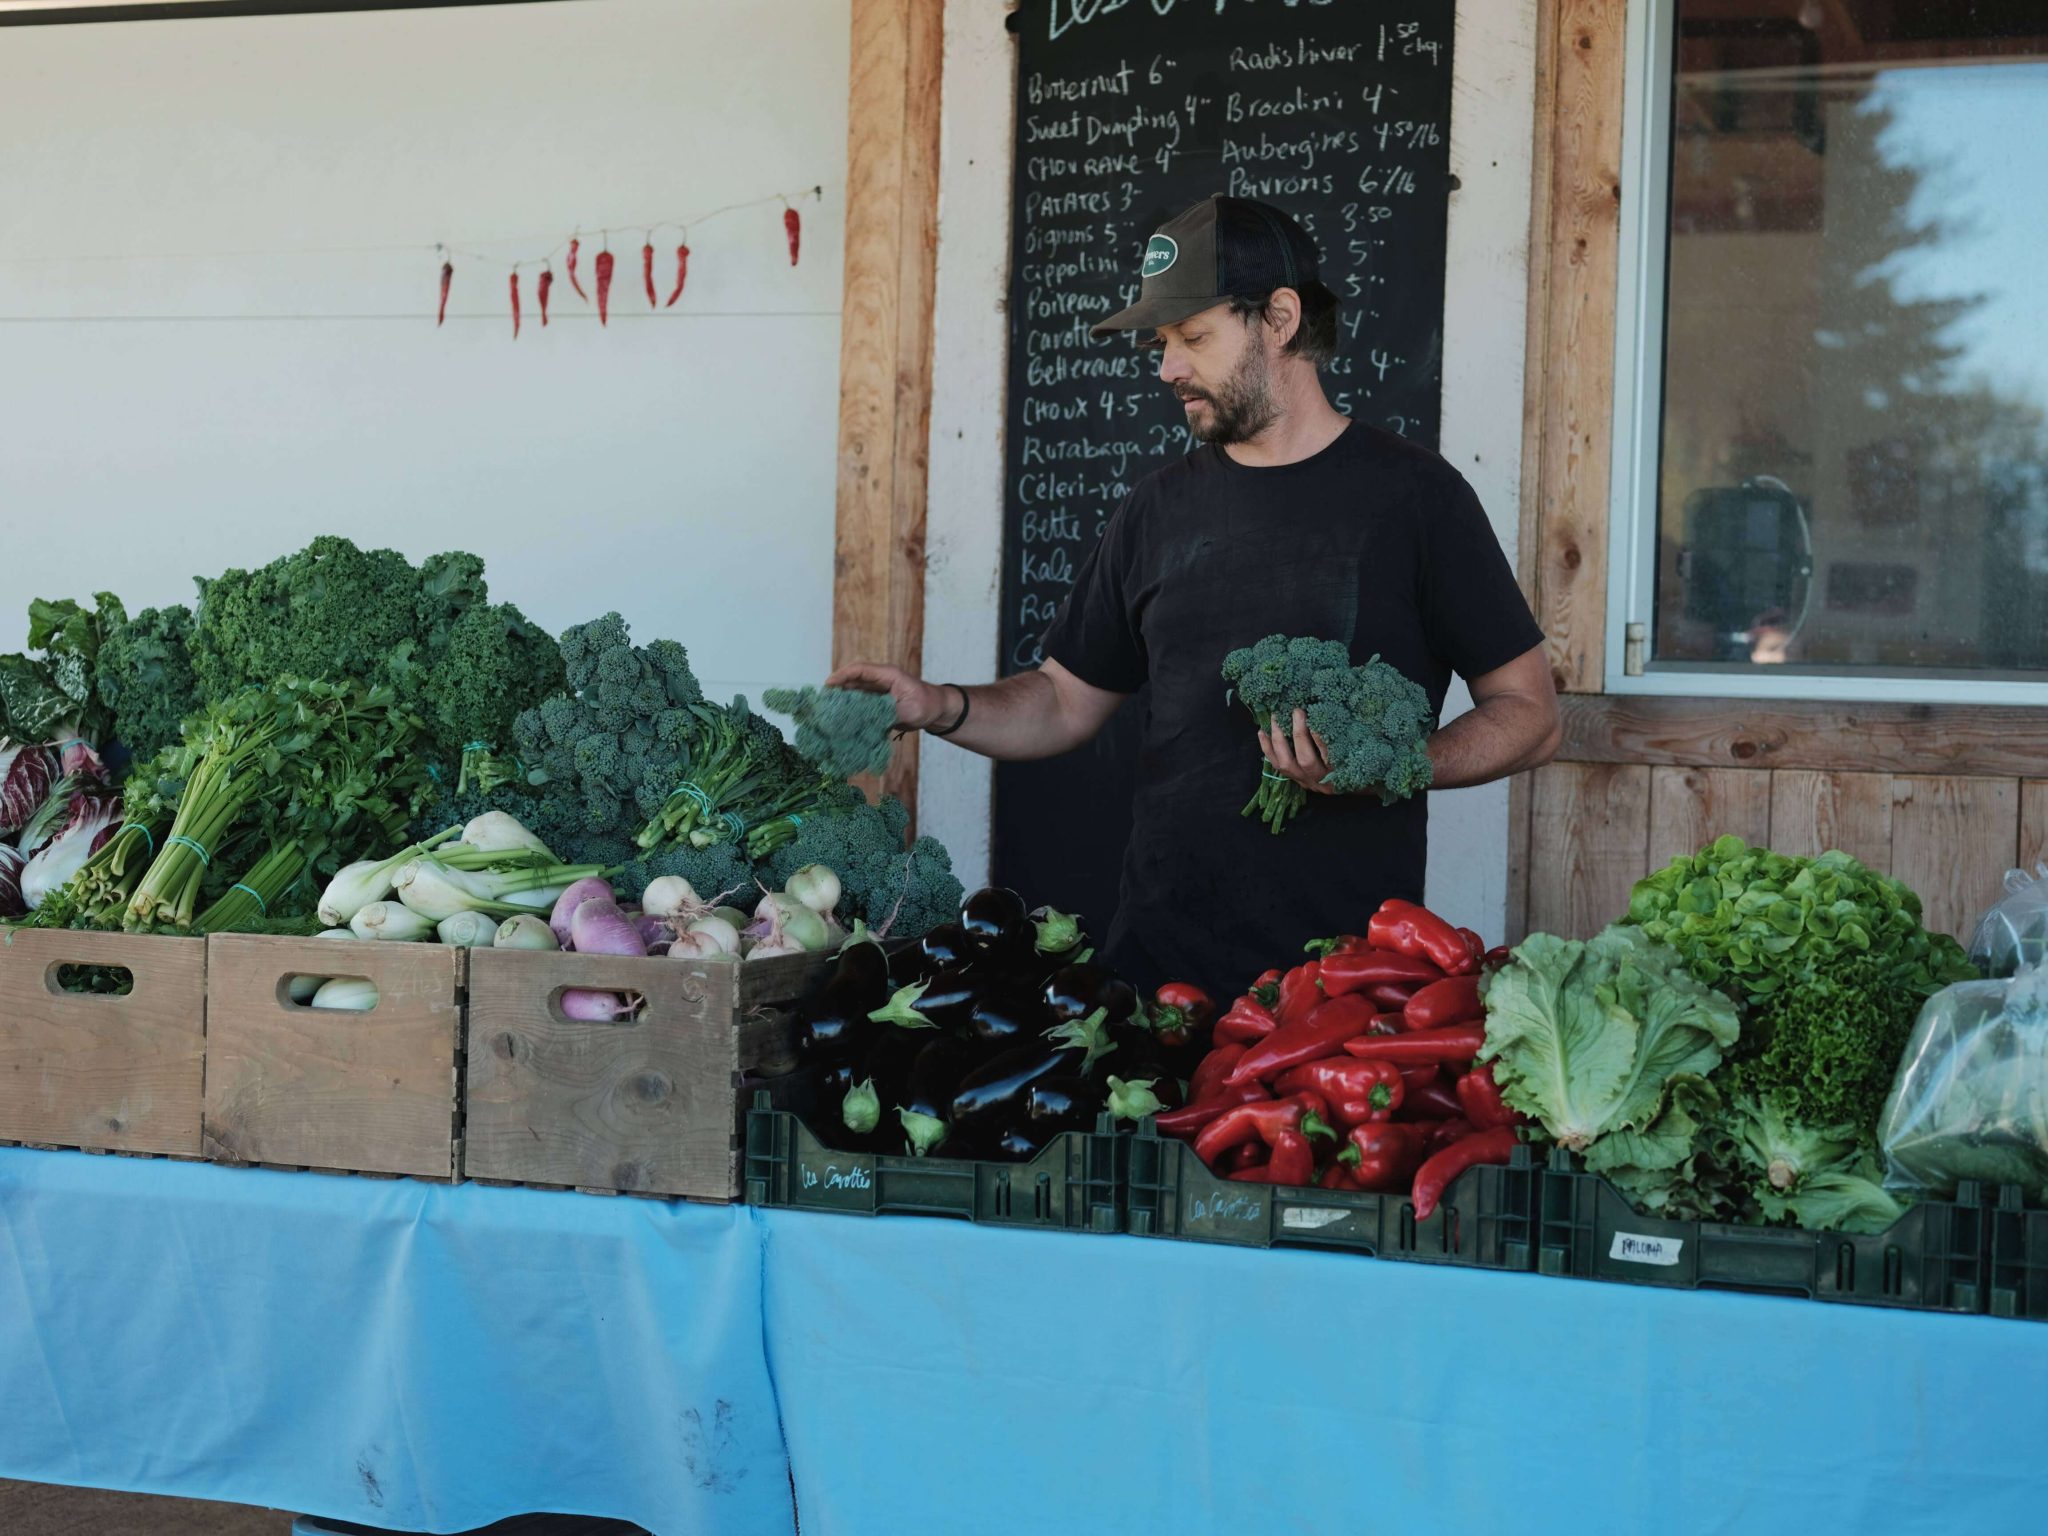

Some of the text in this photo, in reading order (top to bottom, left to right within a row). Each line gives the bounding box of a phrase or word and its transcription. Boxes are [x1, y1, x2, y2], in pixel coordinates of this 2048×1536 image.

[1227, 86, 1342, 122] Brocolini
[1027, 110, 1081, 143] Sweet
[1086, 105, 1181, 149] Dumpling
[1221, 131, 1360, 170] Aubergines
[1228, 166, 1334, 198] Poivrons
[1022, 436, 1143, 478] Rutabaga
[1018, 472, 1131, 505] Céleri-ra
[1022, 505, 1082, 543] Bette
[1021, 547, 1075, 585] Kale
